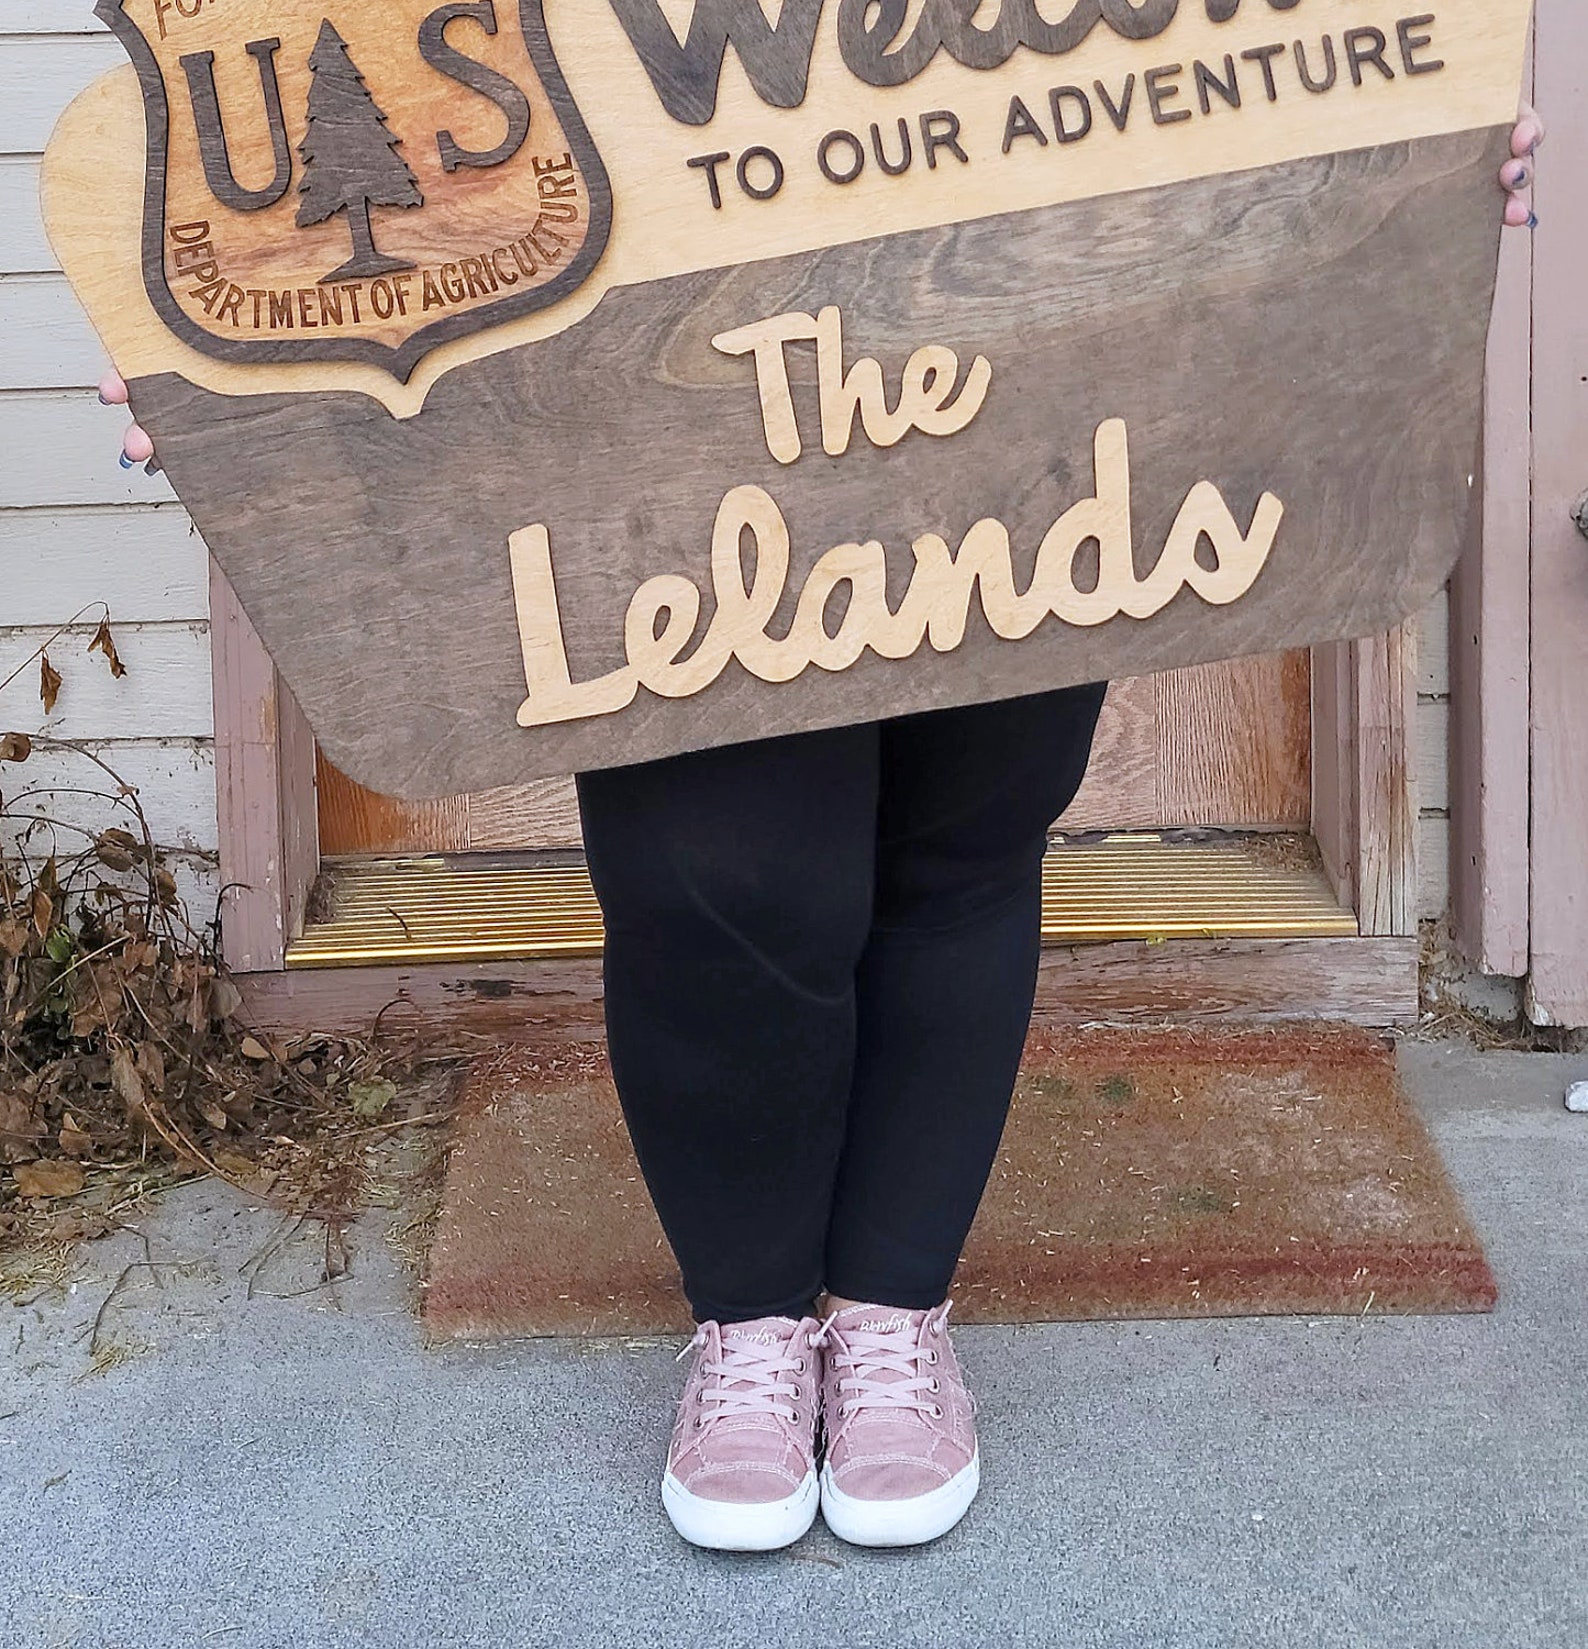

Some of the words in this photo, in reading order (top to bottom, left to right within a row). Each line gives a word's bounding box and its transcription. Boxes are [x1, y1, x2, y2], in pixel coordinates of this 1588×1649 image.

[179, 37, 292, 211] U
[687, 145, 785, 210] TO
[817, 109, 969, 186] OUR
[1001, 13, 1444, 153] ADVENTURE
[170, 219, 363, 329] DEPARTMENT
[369, 275, 409, 320] OF
[422, 152, 579, 312] AGRICULTURE
[711, 305, 992, 464] The
[508, 418, 1284, 727] Lelands
